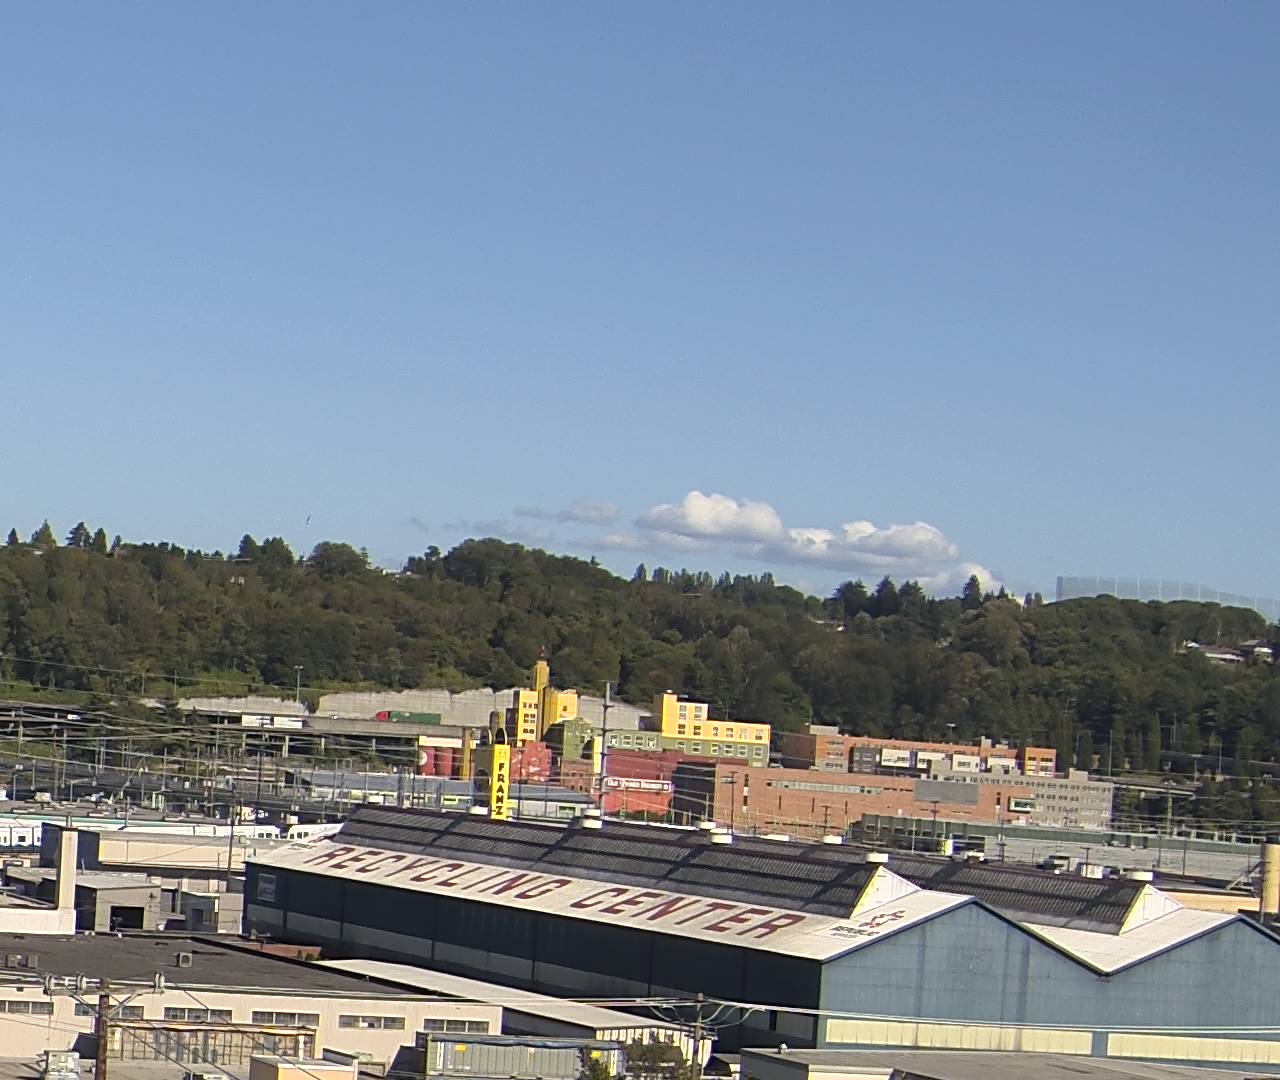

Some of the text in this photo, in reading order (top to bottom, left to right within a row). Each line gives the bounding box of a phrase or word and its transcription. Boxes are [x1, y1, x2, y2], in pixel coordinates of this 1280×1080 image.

[495, 762, 506, 816] FRANZ
[305, 846, 808, 940] RECYCLING CENTER
